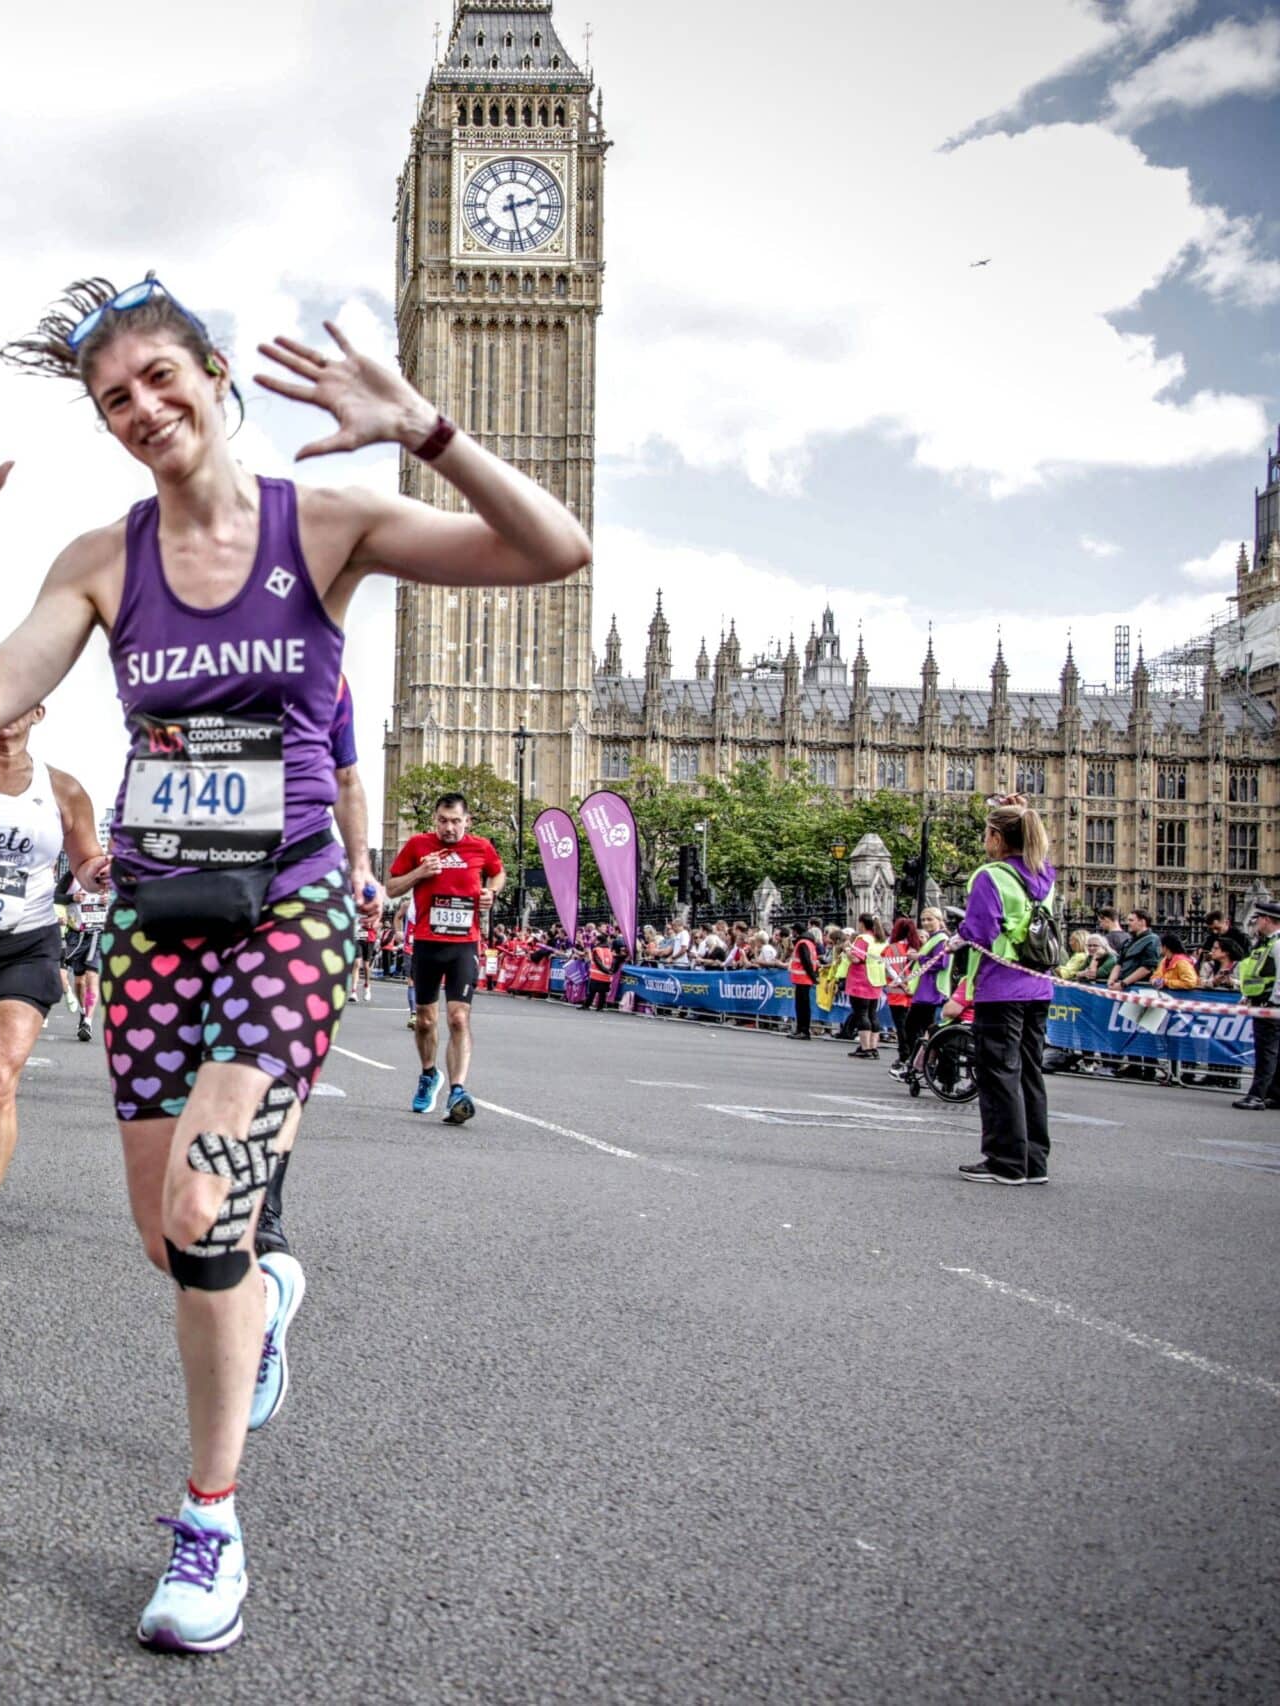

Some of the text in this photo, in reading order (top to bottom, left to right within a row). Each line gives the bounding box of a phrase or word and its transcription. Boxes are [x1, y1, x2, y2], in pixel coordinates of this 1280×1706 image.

[127, 638, 305, 687] SUZANNE
[187, 717, 224, 728] TATA
[187, 727, 272, 742] CONSULTANCY
[187, 741, 243, 754] SERVICES
[152, 772, 245, 815] 4140
[181, 848, 267, 862] new balance
[436, 911, 468, 923] 13197
[719, 979, 766, 1000] Lucozade
[1048, 1004, 1081, 1022] ORT
[1107, 999, 1255, 1043] Luzade
